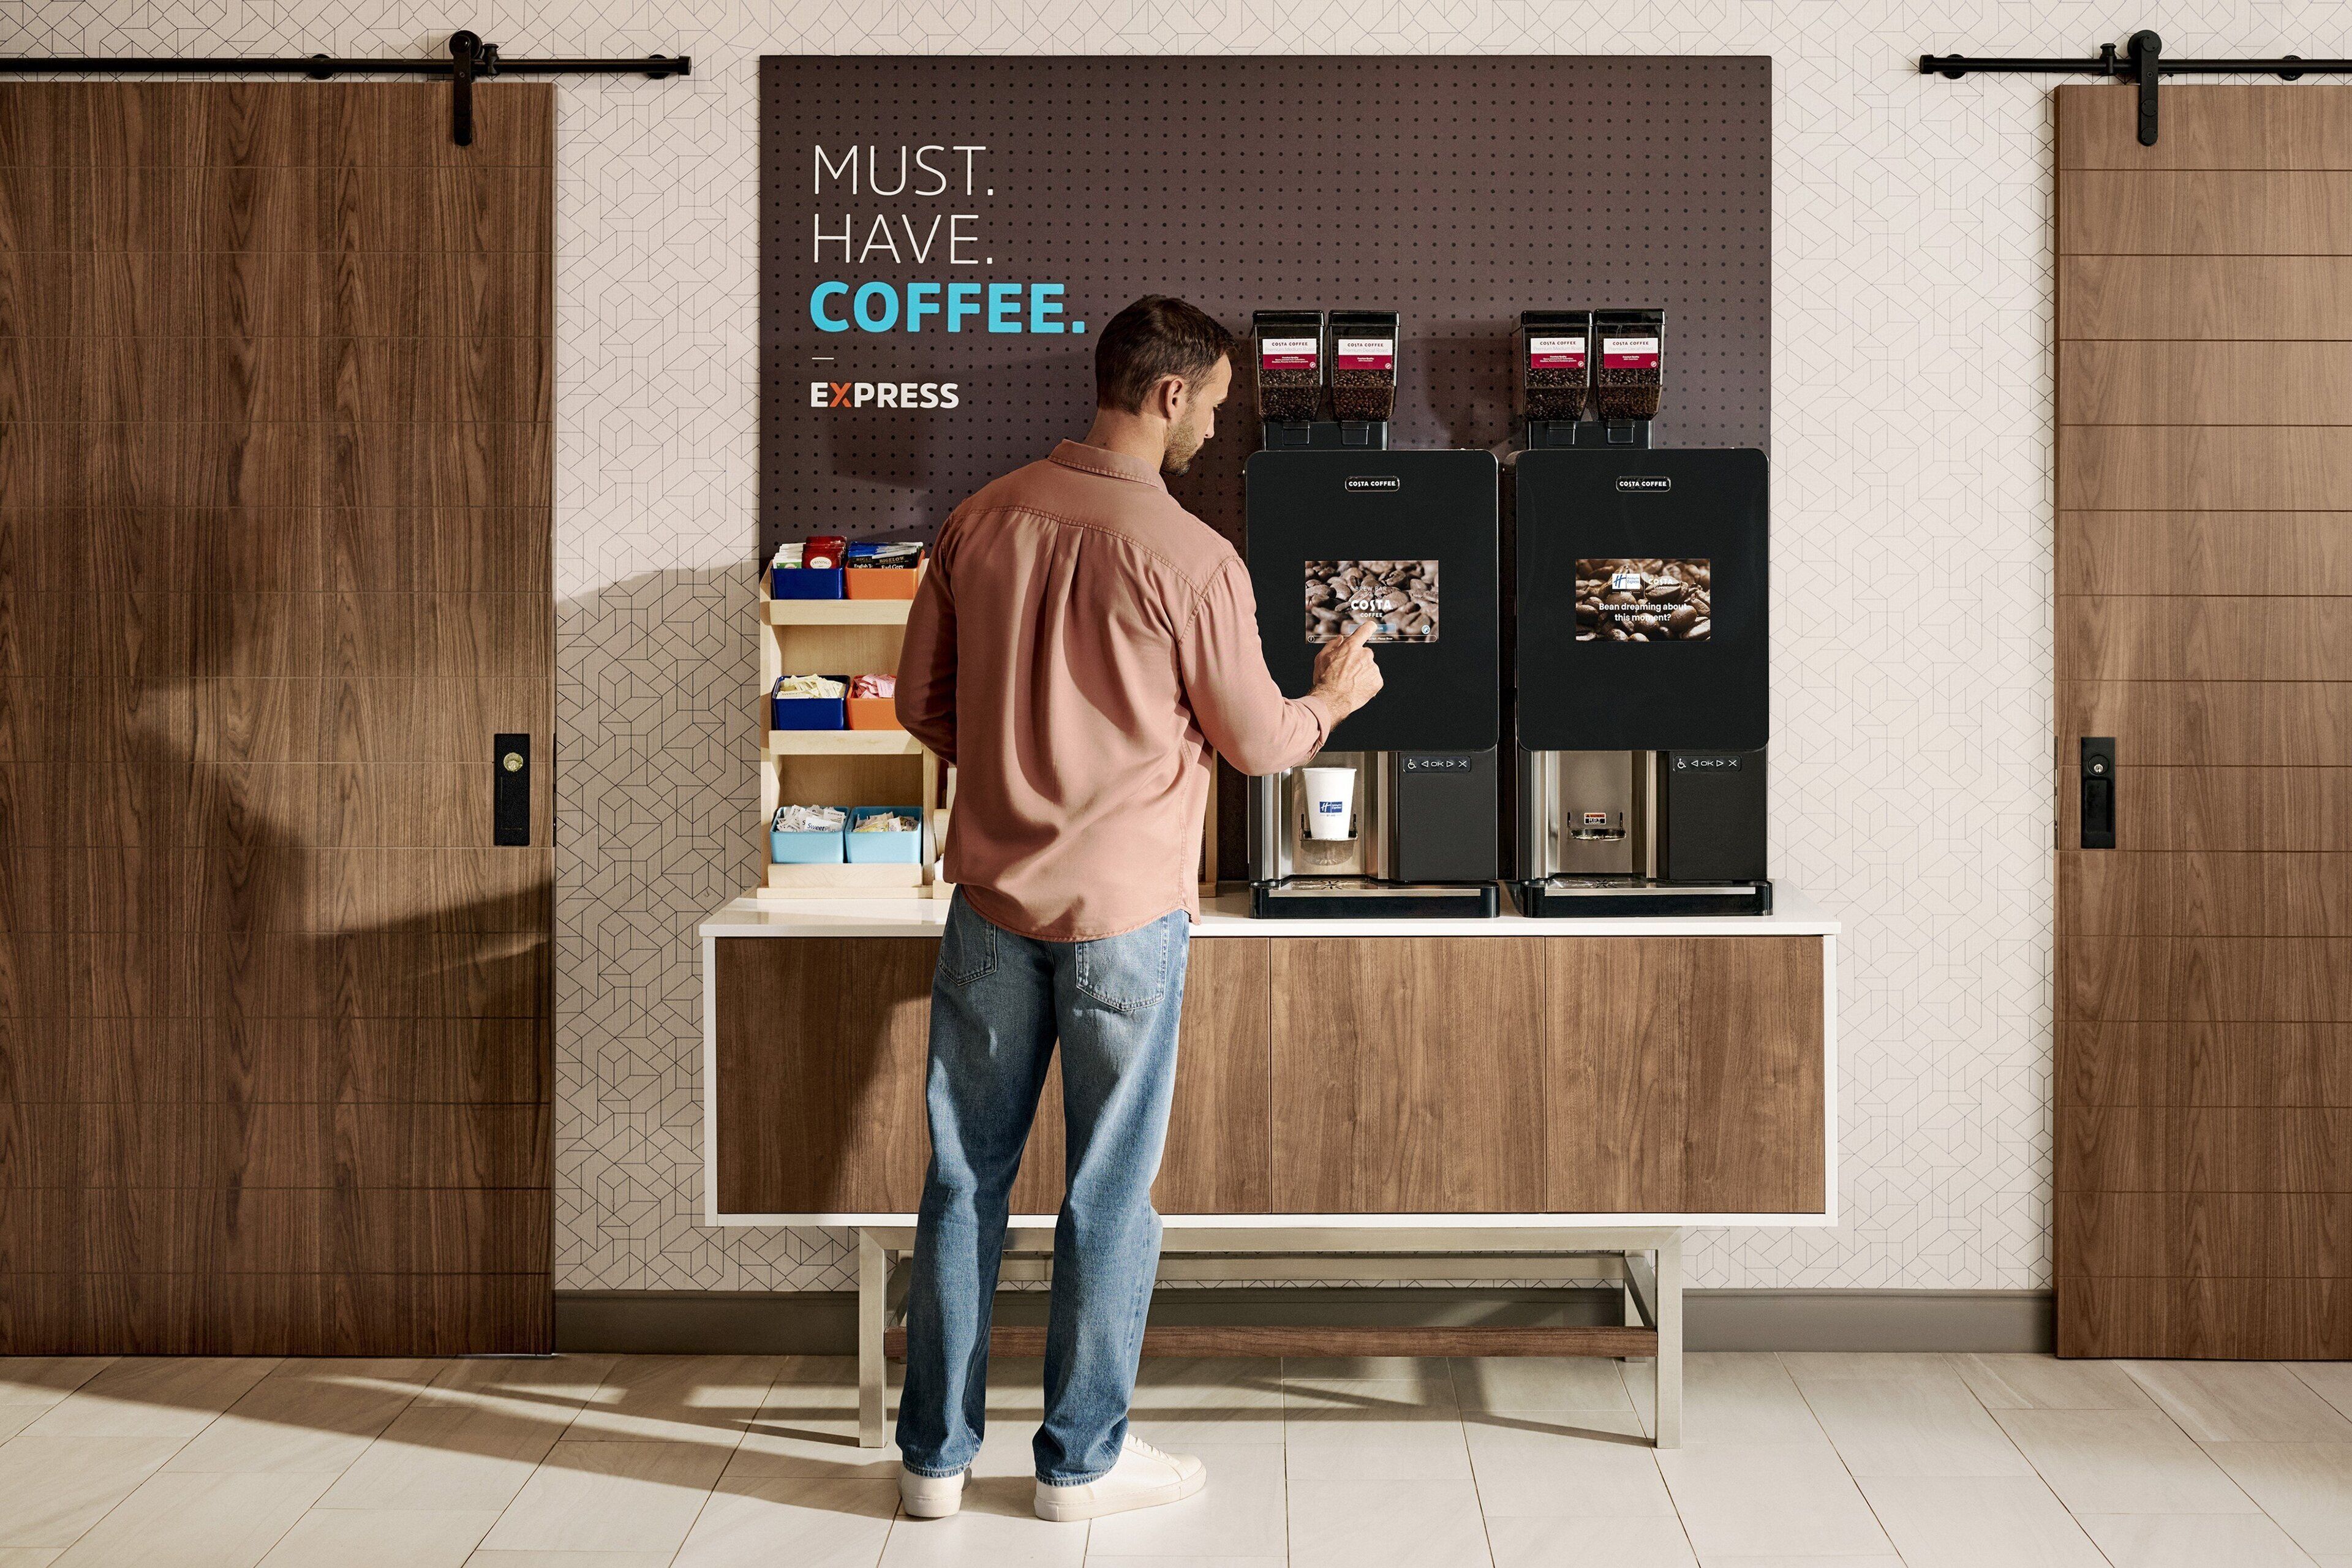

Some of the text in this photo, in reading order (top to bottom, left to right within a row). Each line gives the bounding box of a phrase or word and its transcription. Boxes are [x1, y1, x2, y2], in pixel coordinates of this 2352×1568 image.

[815, 145, 993, 196] MUST.
[814, 213, 993, 265] HAVE.
[810, 281, 1085, 333] COFFEE.
[810, 382, 960, 409] EXPRESS
[1351, 600, 1392, 611] COSTA
[1621, 603, 1661, 611] dreaming
